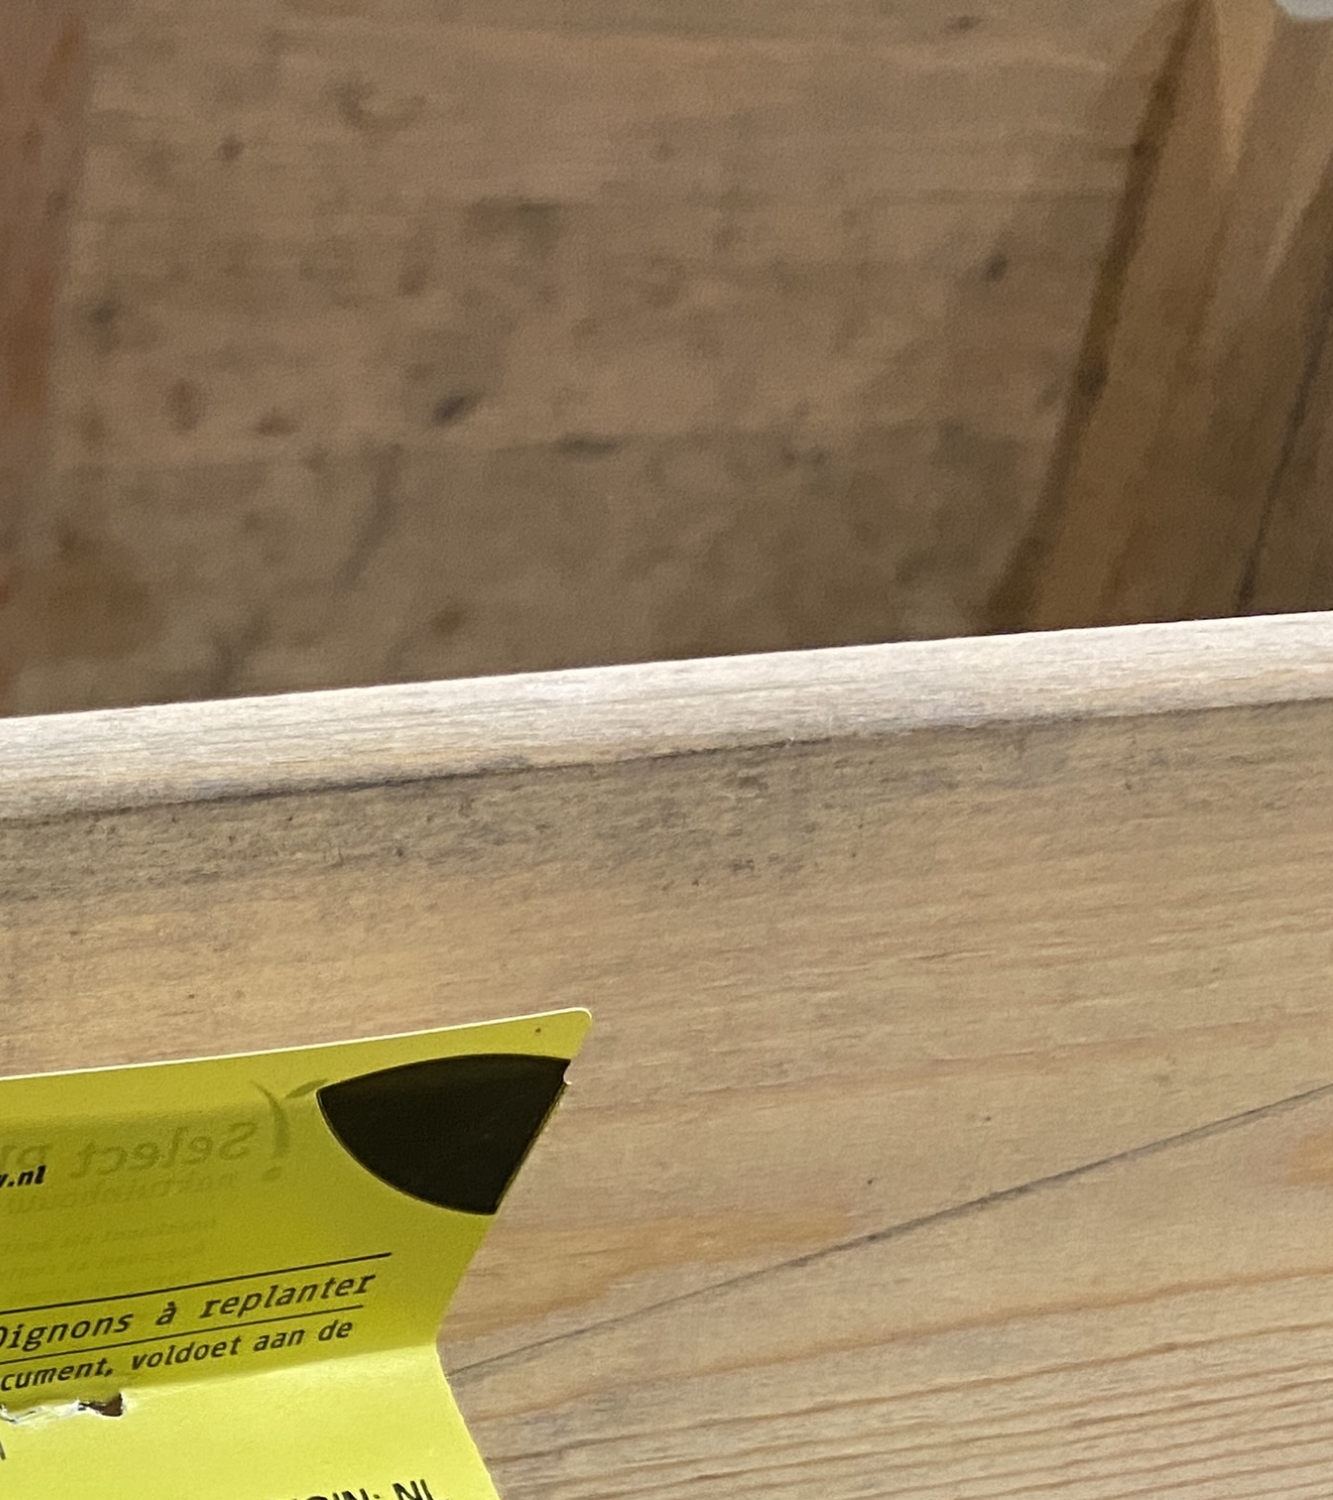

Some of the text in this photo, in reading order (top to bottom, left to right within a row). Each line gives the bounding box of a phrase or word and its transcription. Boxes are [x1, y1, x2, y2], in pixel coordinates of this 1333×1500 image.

[155, 1300, 178, 1326] à
[199, 1274, 377, 1319] replanter
[131, 1335, 242, 1371] voldoet
[252, 1329, 306, 1352] aan
[317, 1319, 354, 1342] de
